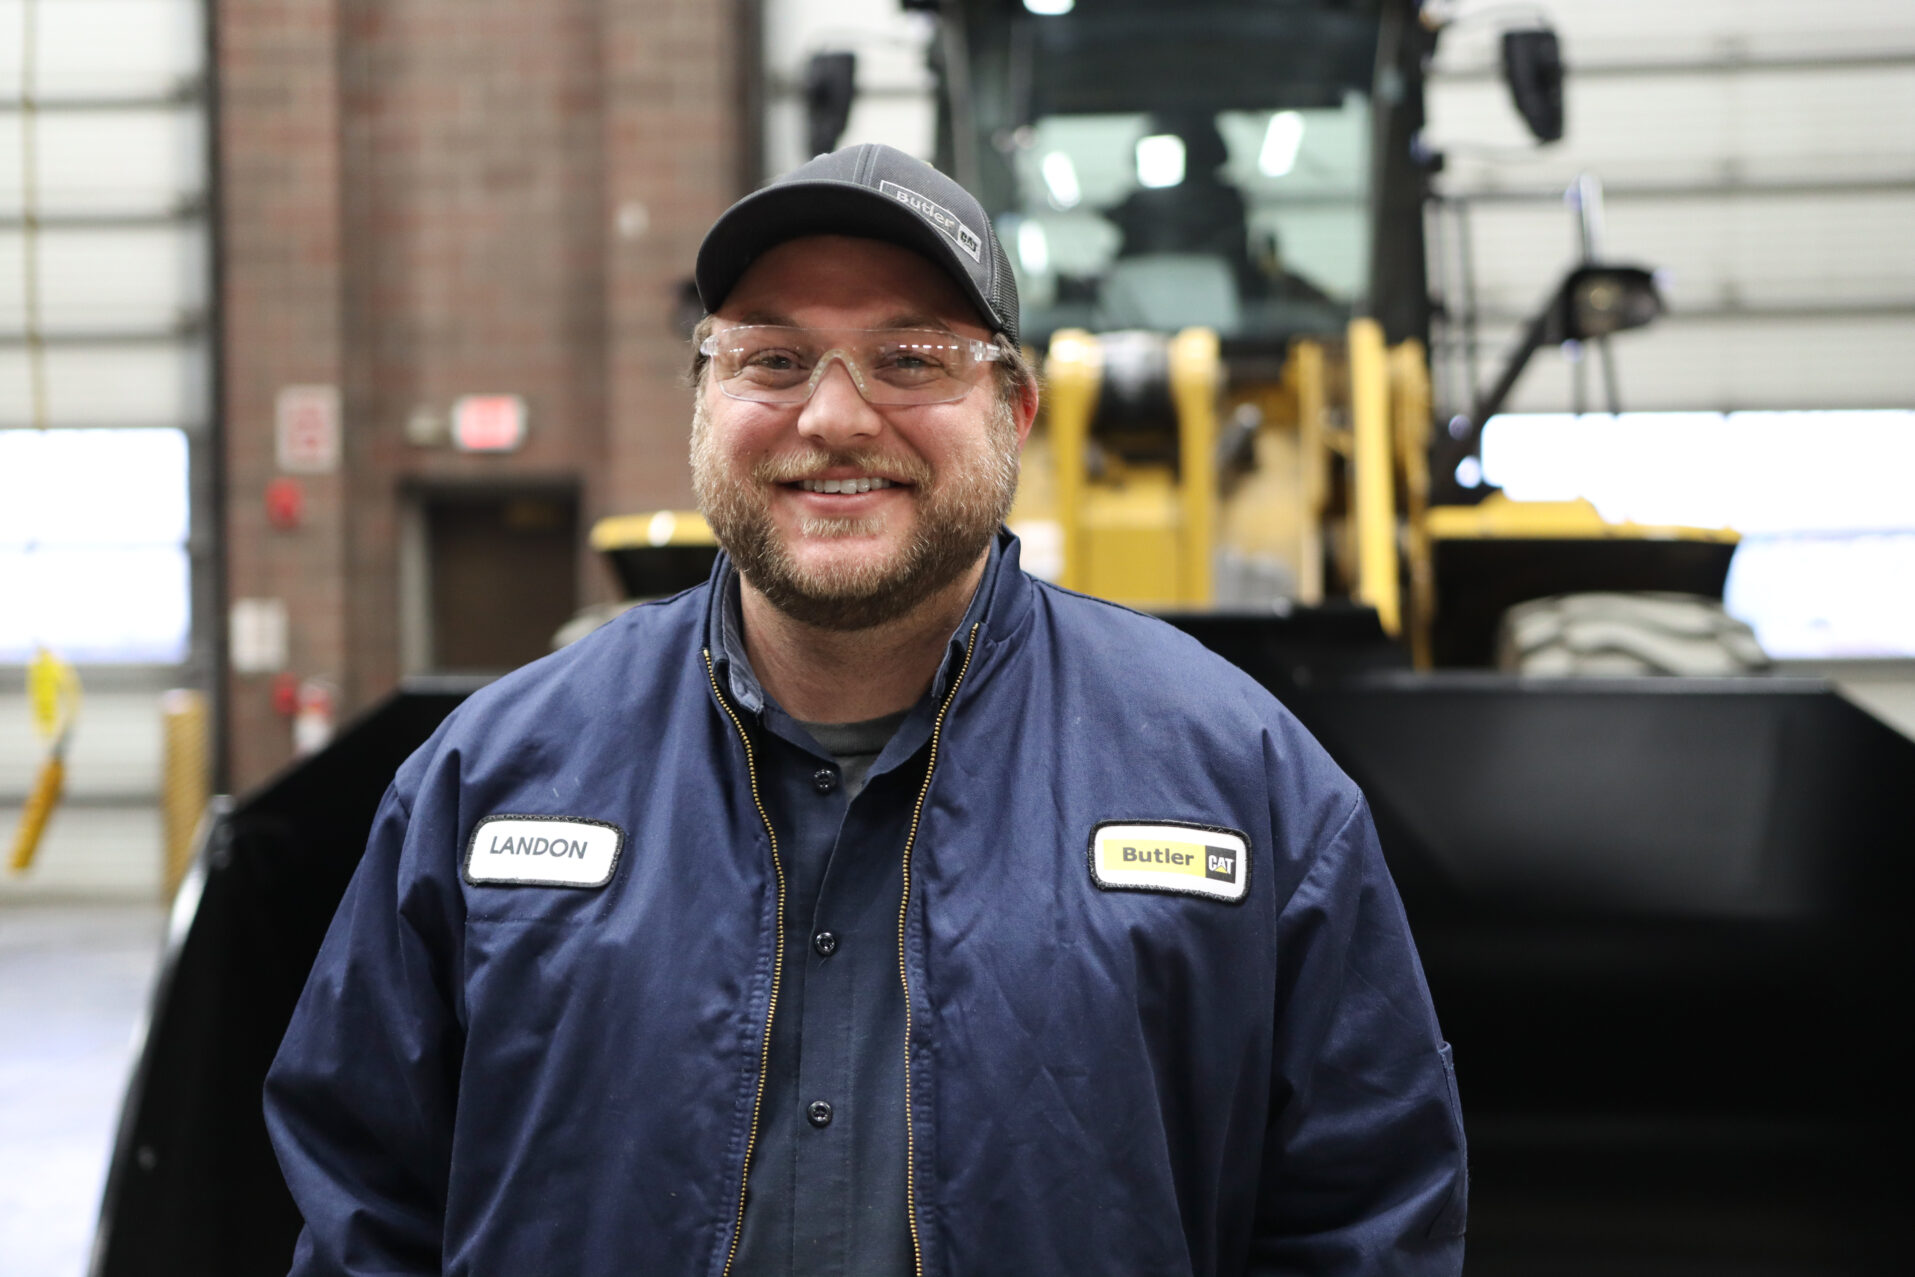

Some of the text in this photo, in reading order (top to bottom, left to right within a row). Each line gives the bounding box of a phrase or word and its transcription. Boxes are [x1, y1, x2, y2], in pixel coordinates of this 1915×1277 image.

[896, 190, 978, 253] Butler CAT
[489, 835, 588, 859] LANDON
[1122, 847, 1235, 874] Butler CAT
